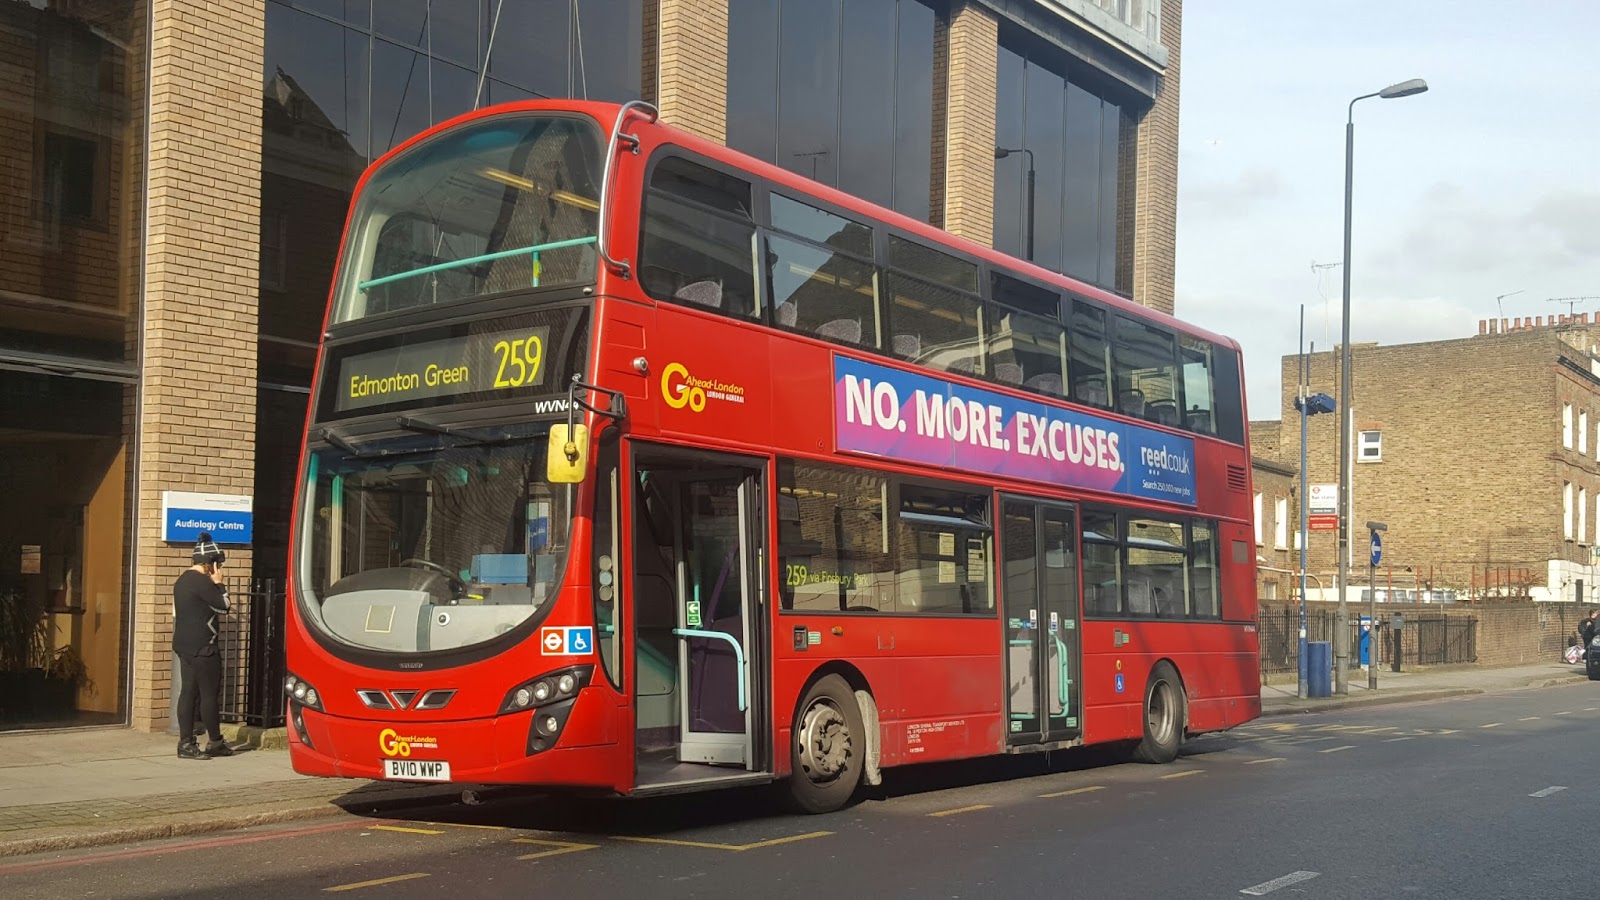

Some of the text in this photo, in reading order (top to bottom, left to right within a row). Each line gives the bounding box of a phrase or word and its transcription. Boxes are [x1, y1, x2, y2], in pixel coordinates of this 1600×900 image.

[493, 335, 543, 388] 259
[350, 364, 469, 399] Edmonton Green
[661, 362, 744, 413] Go Ahead-London
[706, 390, 744, 403] LONDON GENERAL
[844, 374, 1126, 473] NO. MORE. EXCUSES.
[1142, 479, 1157, 490] Search
[174, 519, 245, 531] Audiology Centre
[786, 564, 808, 586] 259
[809, 571, 820, 583] via
[821, 571, 851, 587] Finsbury
[379, 728, 411, 757] Go
[392, 761, 443, 777] BV10 WWP
